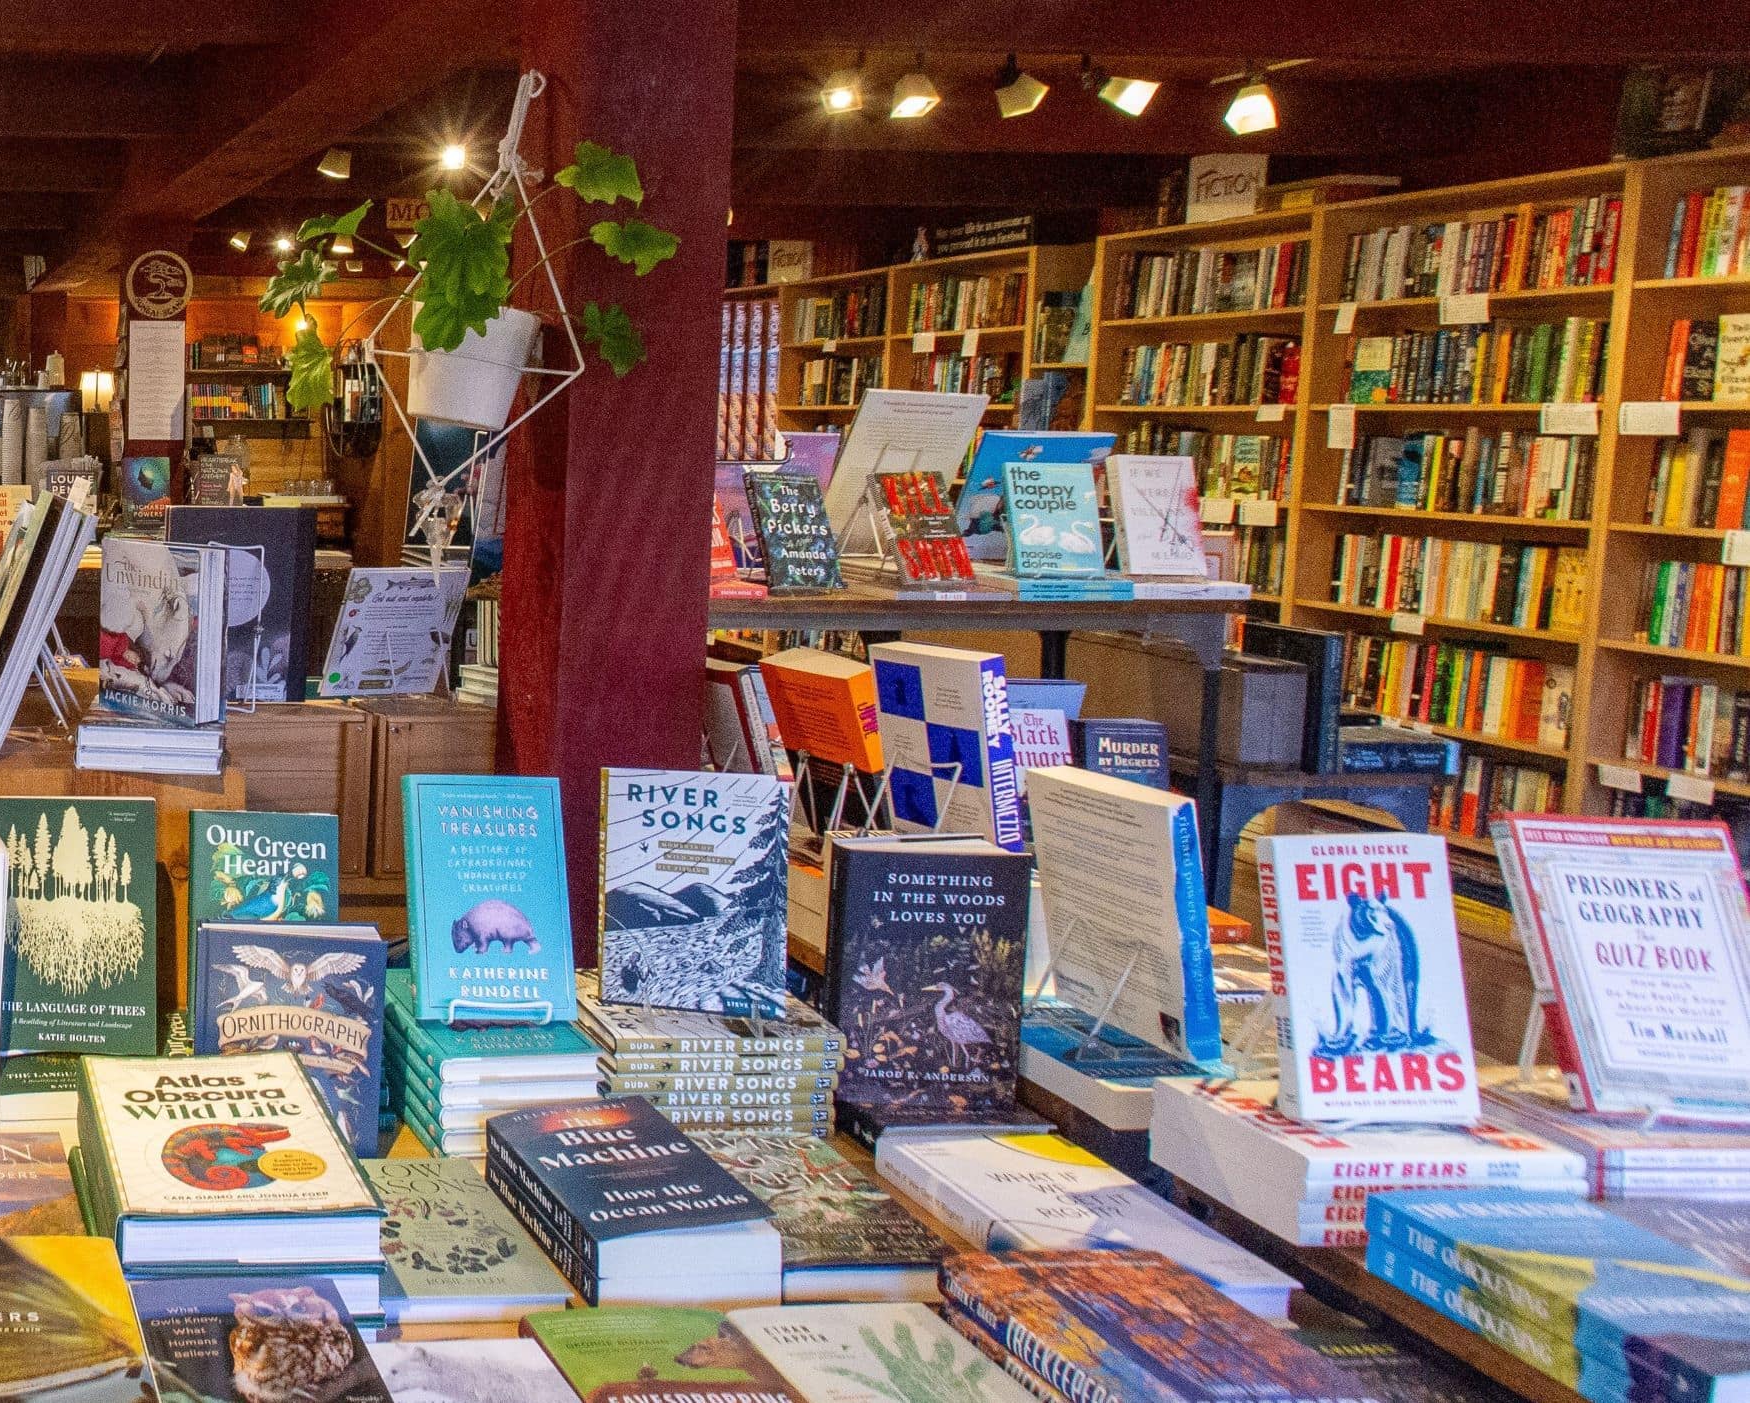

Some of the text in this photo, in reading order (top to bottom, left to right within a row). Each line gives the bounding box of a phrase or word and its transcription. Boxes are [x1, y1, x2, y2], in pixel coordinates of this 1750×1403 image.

[1195, 169, 1260, 204] FICTION
[1010, 467, 1040, 481] the
[780, 485, 799, 497] The
[1013, 481, 1074, 503] happy
[133, 503, 165, 512] RICHARD
[770, 499, 817, 518] Berry
[1014, 497, 1077, 513] couple
[767, 520, 828, 537] Pickers
[780, 548, 827, 560] Amanda
[1021, 550, 1062, 560] naoise
[115, 557, 139, 572] the
[788, 564, 826, 577] Peters
[1022, 558, 1059, 570] dolan
[103, 689, 187, 718] JACKIE MORRIS
[981, 670, 1001, 748] ROONEY
[994, 675, 1013, 736] SALLY
[1098, 737, 1159, 755] MURDER
[627, 783, 719, 808] RIVER
[990, 758, 1018, 844] INTERMEZZO
[437, 804, 539, 821] VANISHING
[441, 821, 538, 837] TREASURES
[641, 809, 747, 835] SONGS
[206, 824, 327, 861] Our Green
[1311, 845, 1409, 856] GLORIA DICKIE
[224, 854, 291, 876] Heart
[457, 872, 527, 881] ENDANGERED
[888, 872, 993, 888] SOMETHING
[1295, 862, 1433, 901] EIGHT
[461, 884, 523, 893] CREATURES
[873, 890, 1006, 907] IN THE WOODS
[890, 910, 988, 925] LOVES YOU
[1579, 900, 1705, 930] GEOGRAPHY
[1595, 941, 1716, 974] QUIZ BOOK
[449, 967, 549, 980] KATHERINE
[460, 985, 541, 999] RUNDELL
[2, 1001, 146, 1017] THE LANGUAGE OF TREES
[38, 1032, 106, 1043] KATIE HOLTEN
[222, 1012, 369, 1051] ORNITHOGRAPHY
[1628, 1020, 1729, 1044] Tim Marshall
[629, 1039, 806, 1053] DUDA RIVER SONGS
[630, 1058, 804, 1072] DUDA RIVER SONGS
[155, 1074, 245, 1089] Atlas
[1309, 1053, 1466, 1094] BEARS
[624, 1077, 798, 1090] DUDA RIVER SONGS
[124, 1088, 286, 1103] Obscura
[667, 1092, 792, 1105] RIVER SONGS
[122, 1101, 302, 1121] Wild Life
[671, 1110, 794, 1123] RIVER SONGS
[554, 1126, 638, 1147] Blue
[538, 1140, 692, 1172] Machine
[490, 1134, 552, 1213] The Blue Machine
[987, 1171, 1079, 1184] WHAT IF
[603, 1182, 704, 1203] How the
[1030, 1183, 1066, 1195] WE
[490, 1167, 553, 1249] The Blue Machine
[589, 1191, 749, 1223] Ocean Works
[165, 1305, 199, 1314] What
[150, 1316, 222, 1326] Owls Know,
[172, 1326, 206, 1336] What
[763, 1325, 810, 1336] ETHAN
[168, 1338, 218, 1348] Humans
[773, 1334, 830, 1344] TAPPER
[174, 1350, 219, 1359] Believe
